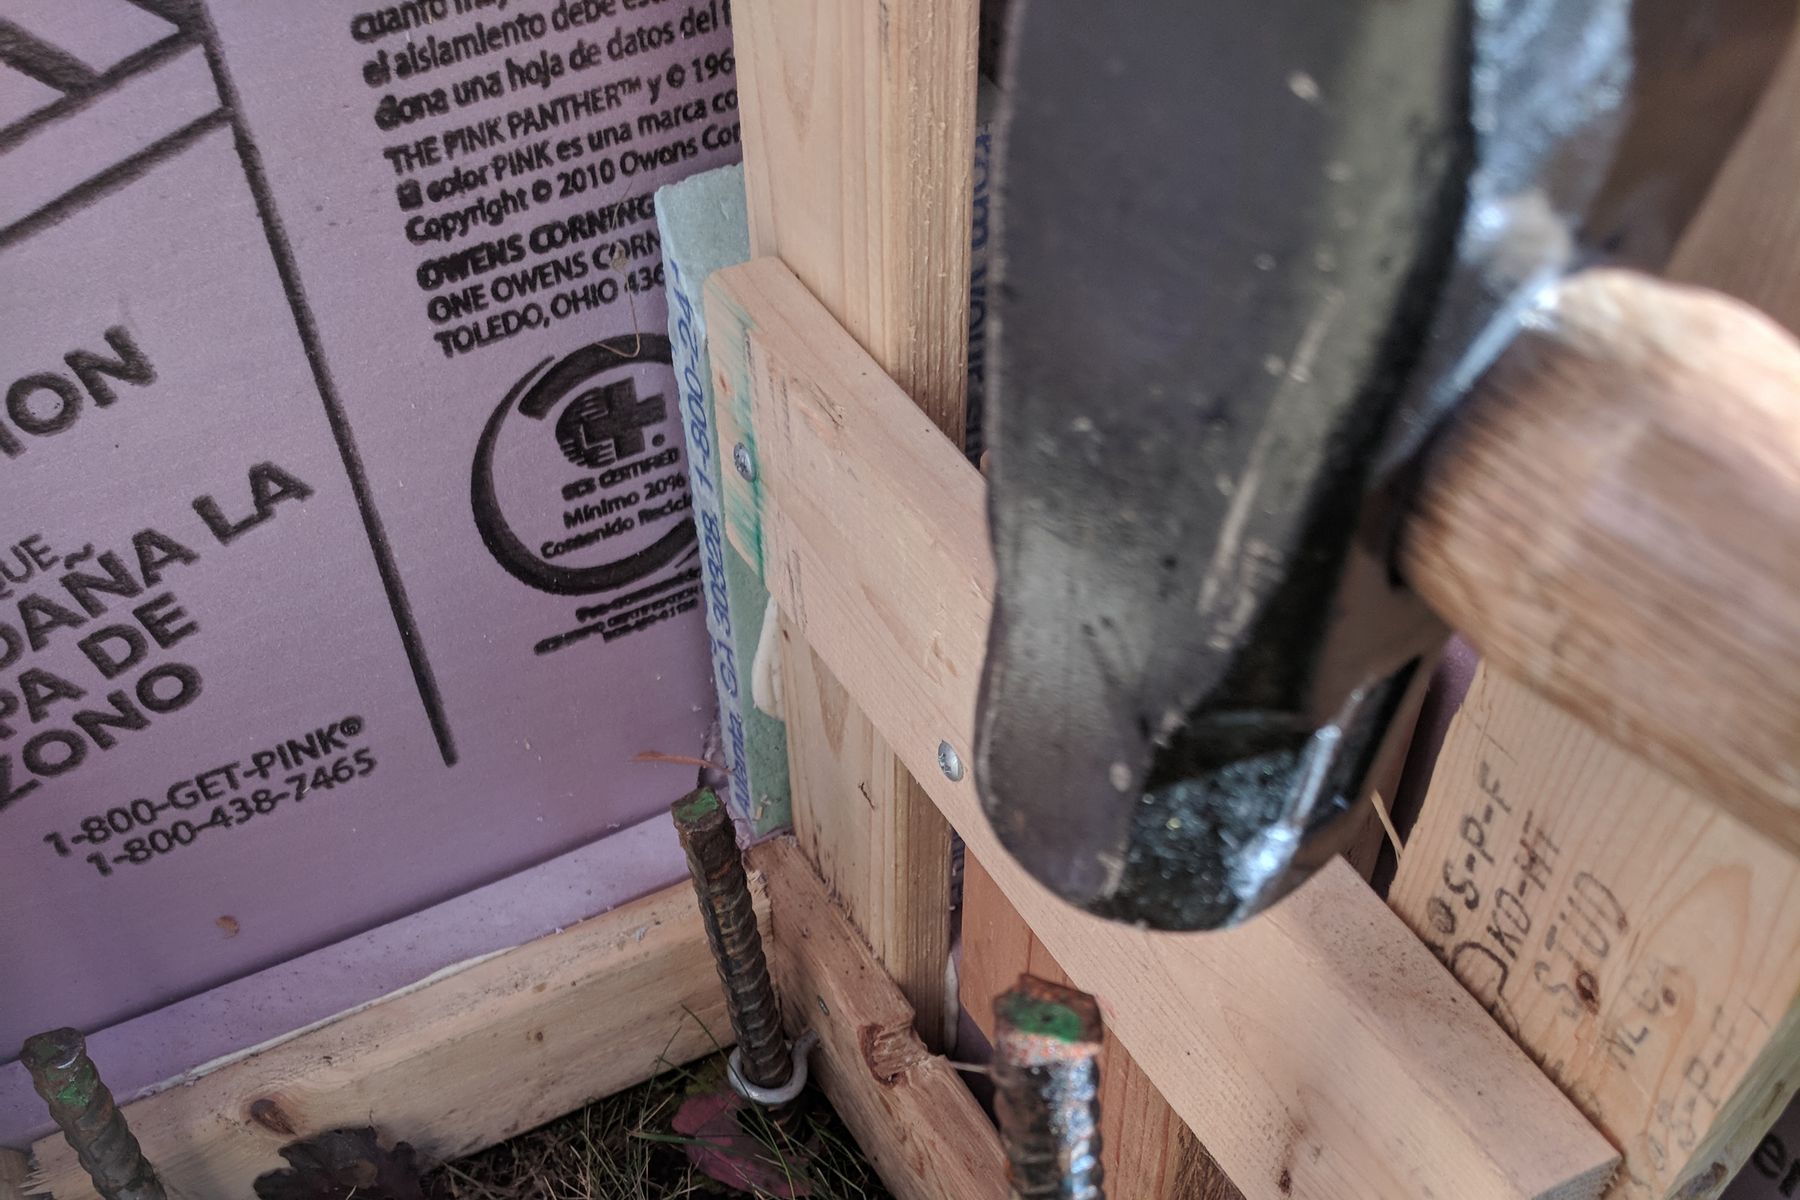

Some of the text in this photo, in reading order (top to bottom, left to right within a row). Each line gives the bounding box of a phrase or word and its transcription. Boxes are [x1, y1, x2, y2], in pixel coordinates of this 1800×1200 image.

[395, 13, 547, 79] aislamiento
[452, 70, 504, 107] una
[505, 50, 564, 91] hoja
[569, 38, 601, 71] de
[606, 26, 675, 61] datos
[679, 0, 718, 39] del
[383, 136, 441, 175] THE
[443, 116, 506, 160] PINK
[647, 74, 661, 105] y
[426, 166, 488, 203] color
[491, 140, 554, 181] PINK
[556, 136, 584, 162] es
[587, 122, 632, 153] una
[637, 98, 707, 137] marca
[404, 187, 529, 246] Copyright
[557, 158, 615, 199] 2010
[416, 191, 656, 291] OWENS CORNING
[427, 283, 490, 325] ONE
[490, 250, 589, 303] OWENS
[433, 302, 550, 358] TOLEDO,
[550, 277, 618, 320] OHIO
[192, 461, 314, 547] LA
[0, 533, 61, 600] UE
[77, 591, 200, 680] DE
[88, 748, 377, 877] 1-800-438-7465
[1443, 761, 1511, 909] S-P-F
